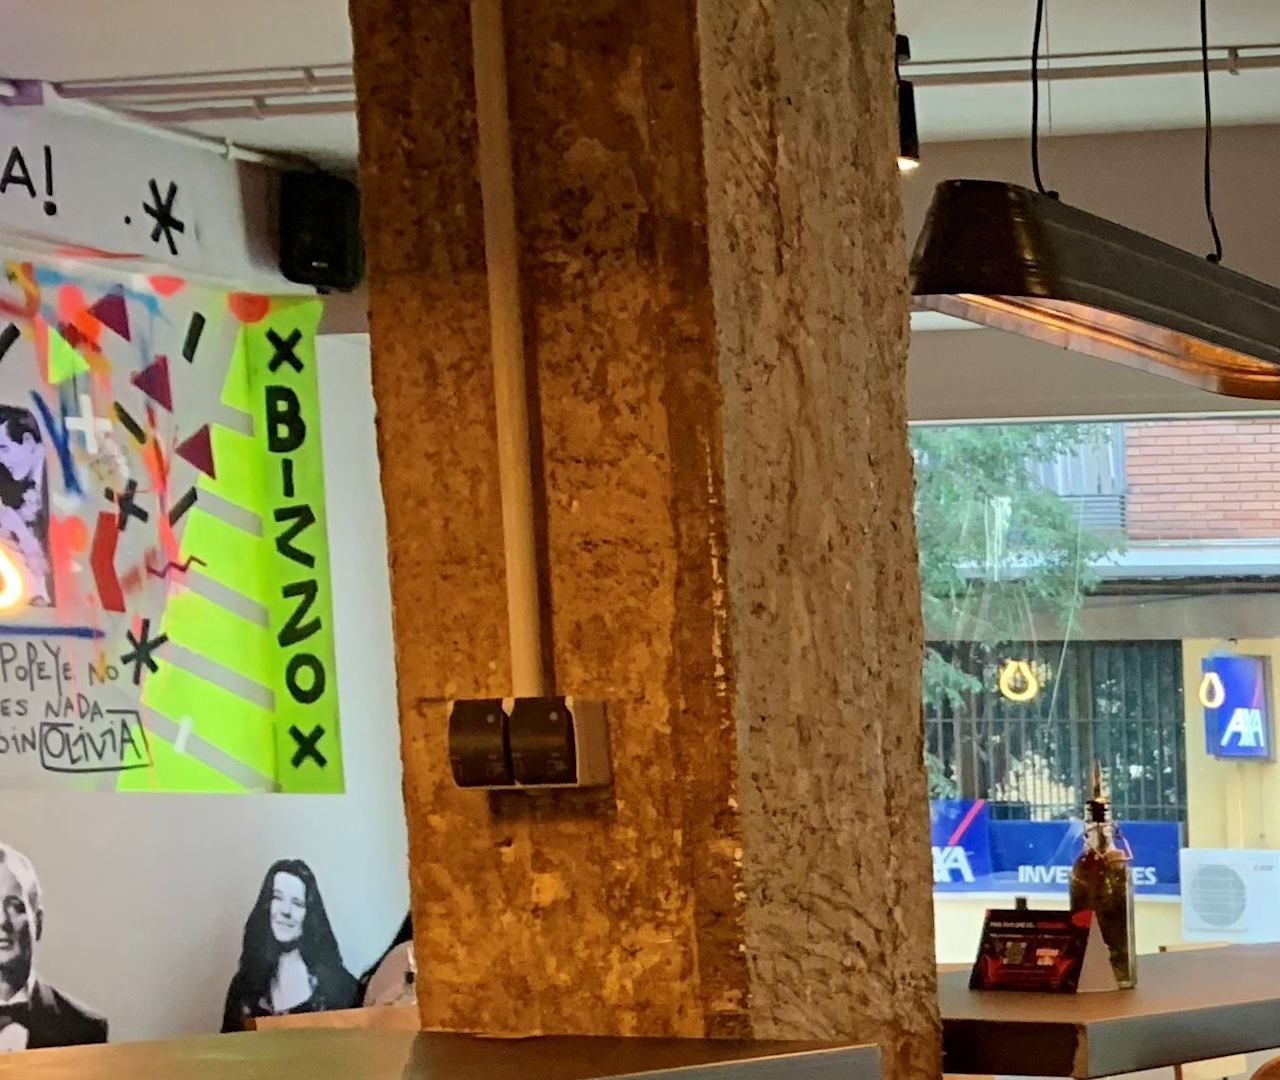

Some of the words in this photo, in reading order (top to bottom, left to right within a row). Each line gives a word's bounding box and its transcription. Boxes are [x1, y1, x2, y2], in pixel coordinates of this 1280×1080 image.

[87, 662, 119, 687] NO
[0, 698, 28, 717] ES
[44, 692, 104, 722] NADA
[1219, 707, 1266, 748] AXA
